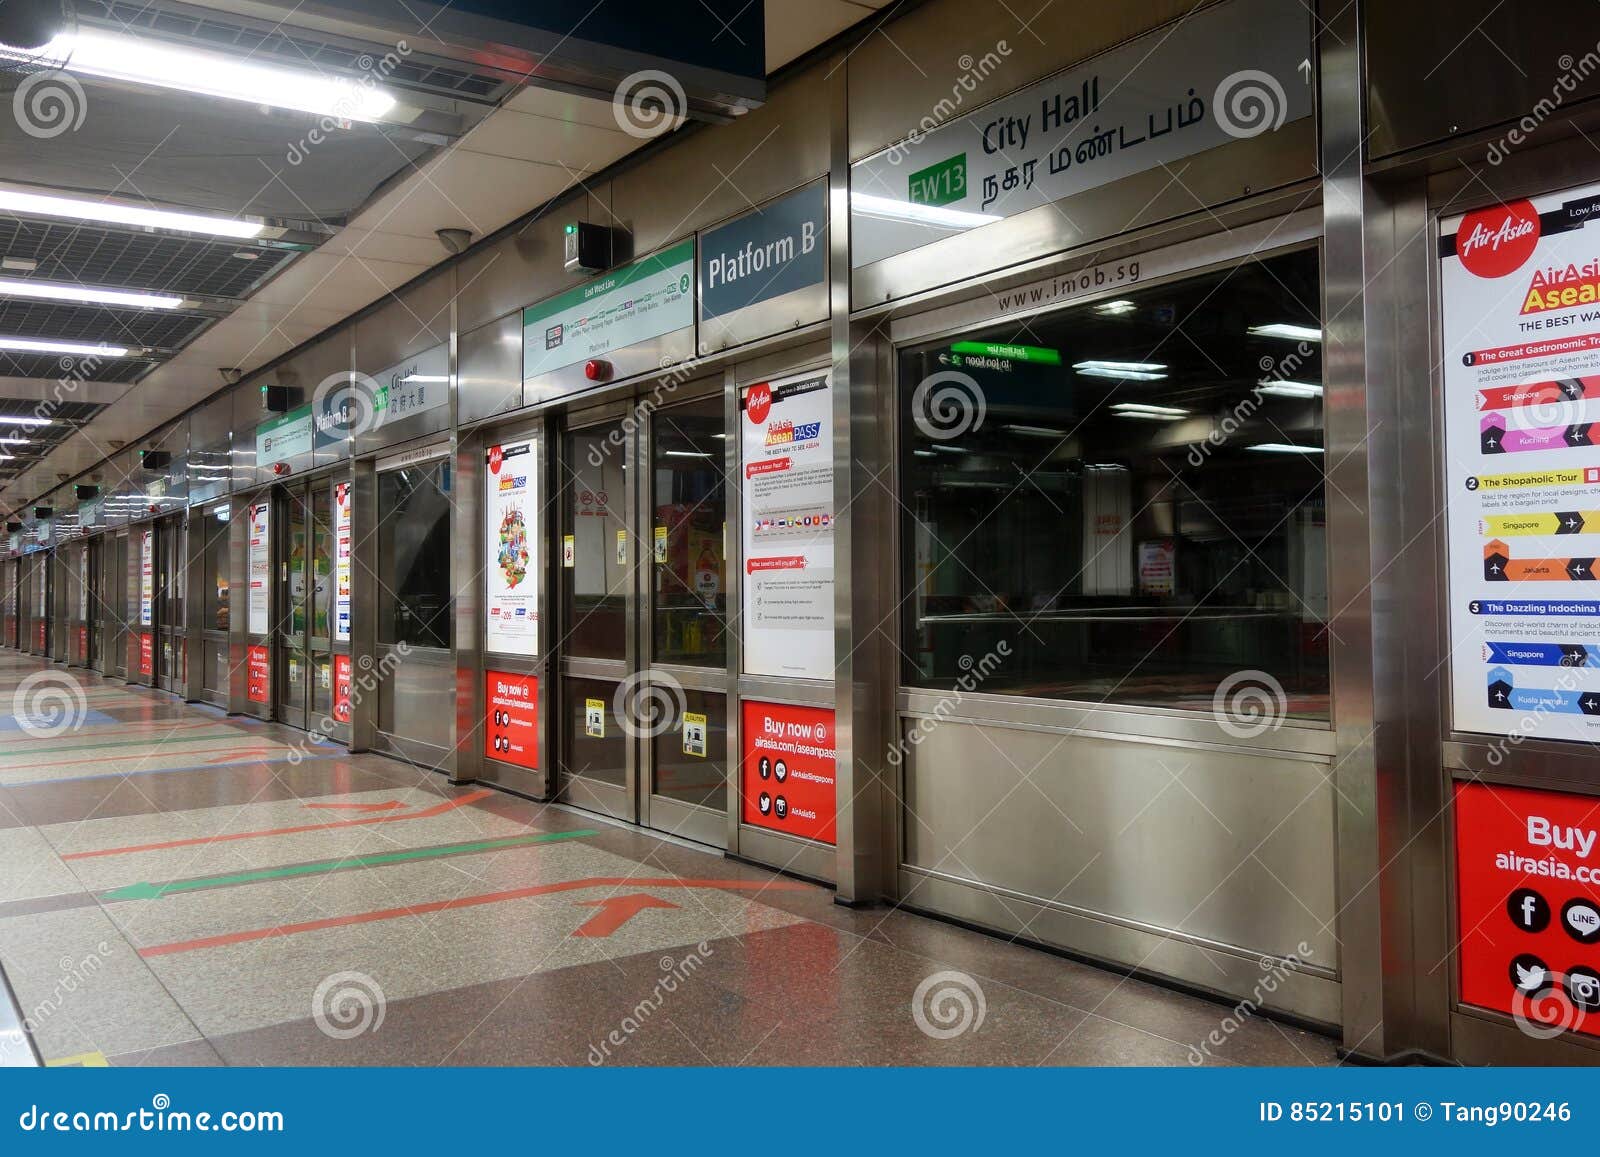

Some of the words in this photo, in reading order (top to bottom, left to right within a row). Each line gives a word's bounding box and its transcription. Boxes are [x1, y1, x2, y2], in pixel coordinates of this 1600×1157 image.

[982, 114, 1031, 155] City
[1042, 76, 1099, 132] Hall
[982, 159, 1037, 211] நகர
[1050, 88, 1204, 174] மண்டபம்
[1569, 207, 1590, 217] Low
[1463, 216, 1534, 257] AirAsia
[709, 241, 794, 288] Platform
[802, 221, 815, 254] B
[681, 277, 690, 291] 2
[998, 261, 1140, 311] www.imob.sg
[1524, 283, 1600, 312] Asea
[1519, 320, 1542, 332] THE
[1546, 314, 1576, 328] BEST
[1480, 353, 1496, 361] The
[1499, 349, 1523, 359] Great
[1526, 340, 1586, 355] Gastronomic
[1465, 355, 1472, 364] 1
[1503, 391, 1540, 401] Singapore
[1468, 480, 1475, 488] 2
[1484, 479, 1500, 487] The
[1503, 475, 1553, 486] Shopaholic
[1556, 473, 1578, 482] Tour
[1509, 491, 1530, 500] region
[1543, 489, 1558, 497] local
[1503, 521, 1539, 531] Singapore
[1471, 603, 1479, 612] 3
[1506, 603, 1546, 613] Dazzling
[1548, 604, 1596, 613] Indochina
[1540, 628, 1568, 637] beautiful
[1507, 650, 1544, 661] Singapore
[764, 717, 785, 737] Buy
[787, 721, 811, 738] now
[814, 722, 826, 744] @
[755, 736, 837, 760] airasia.com/aseanpass
[1527, 816, 1597, 858] Buy
[1572, 912, 1597, 925] LINE
